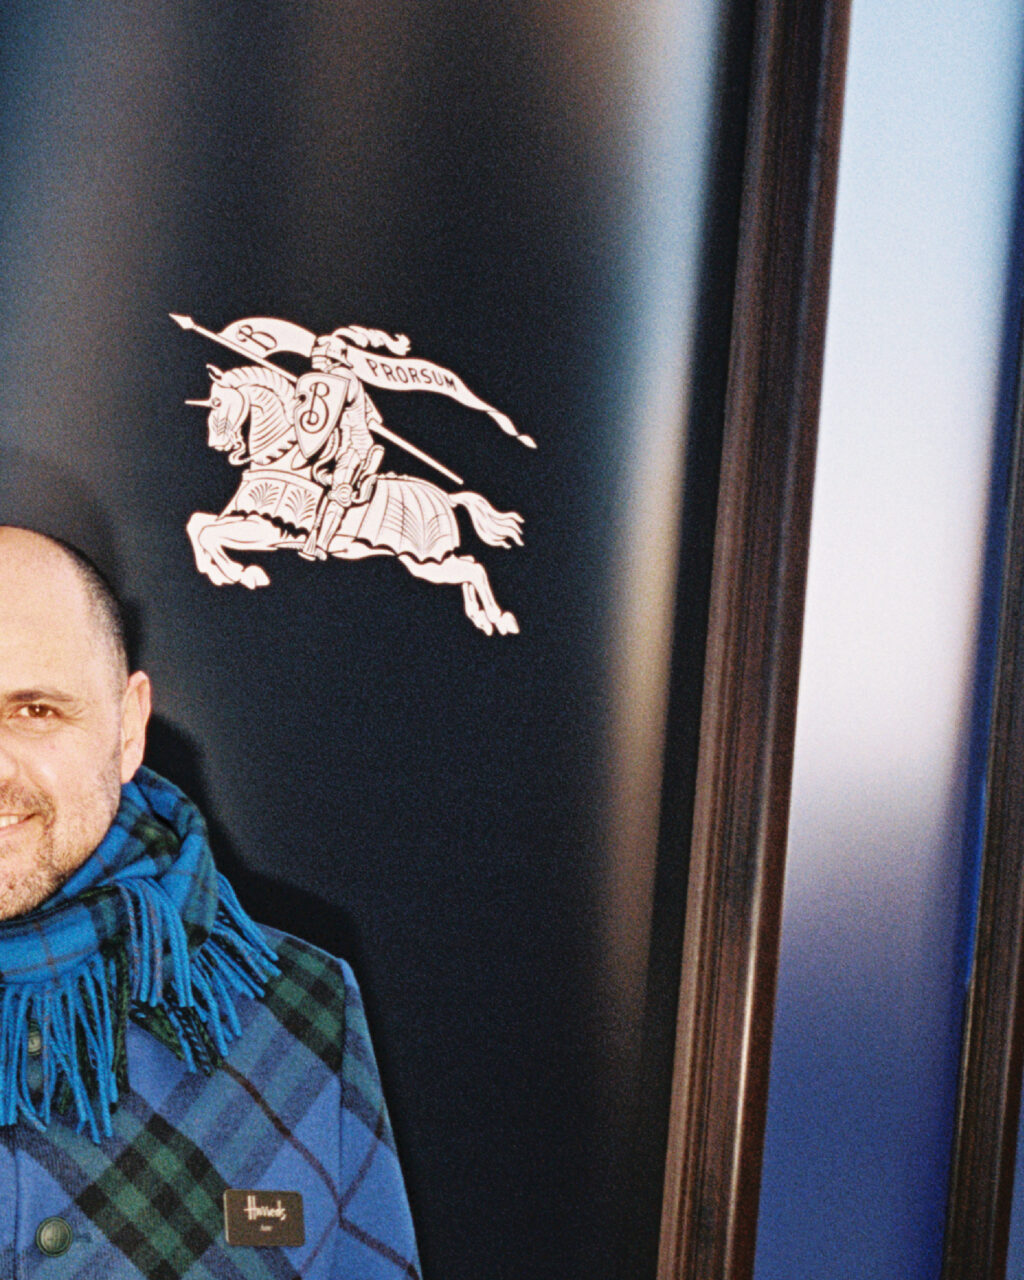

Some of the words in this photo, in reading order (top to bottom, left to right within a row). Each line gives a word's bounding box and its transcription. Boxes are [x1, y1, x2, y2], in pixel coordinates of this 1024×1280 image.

[237, 324, 278, 352] B
[365, 358, 457, 392] PRORSUM
[299, 381, 330, 434] B
